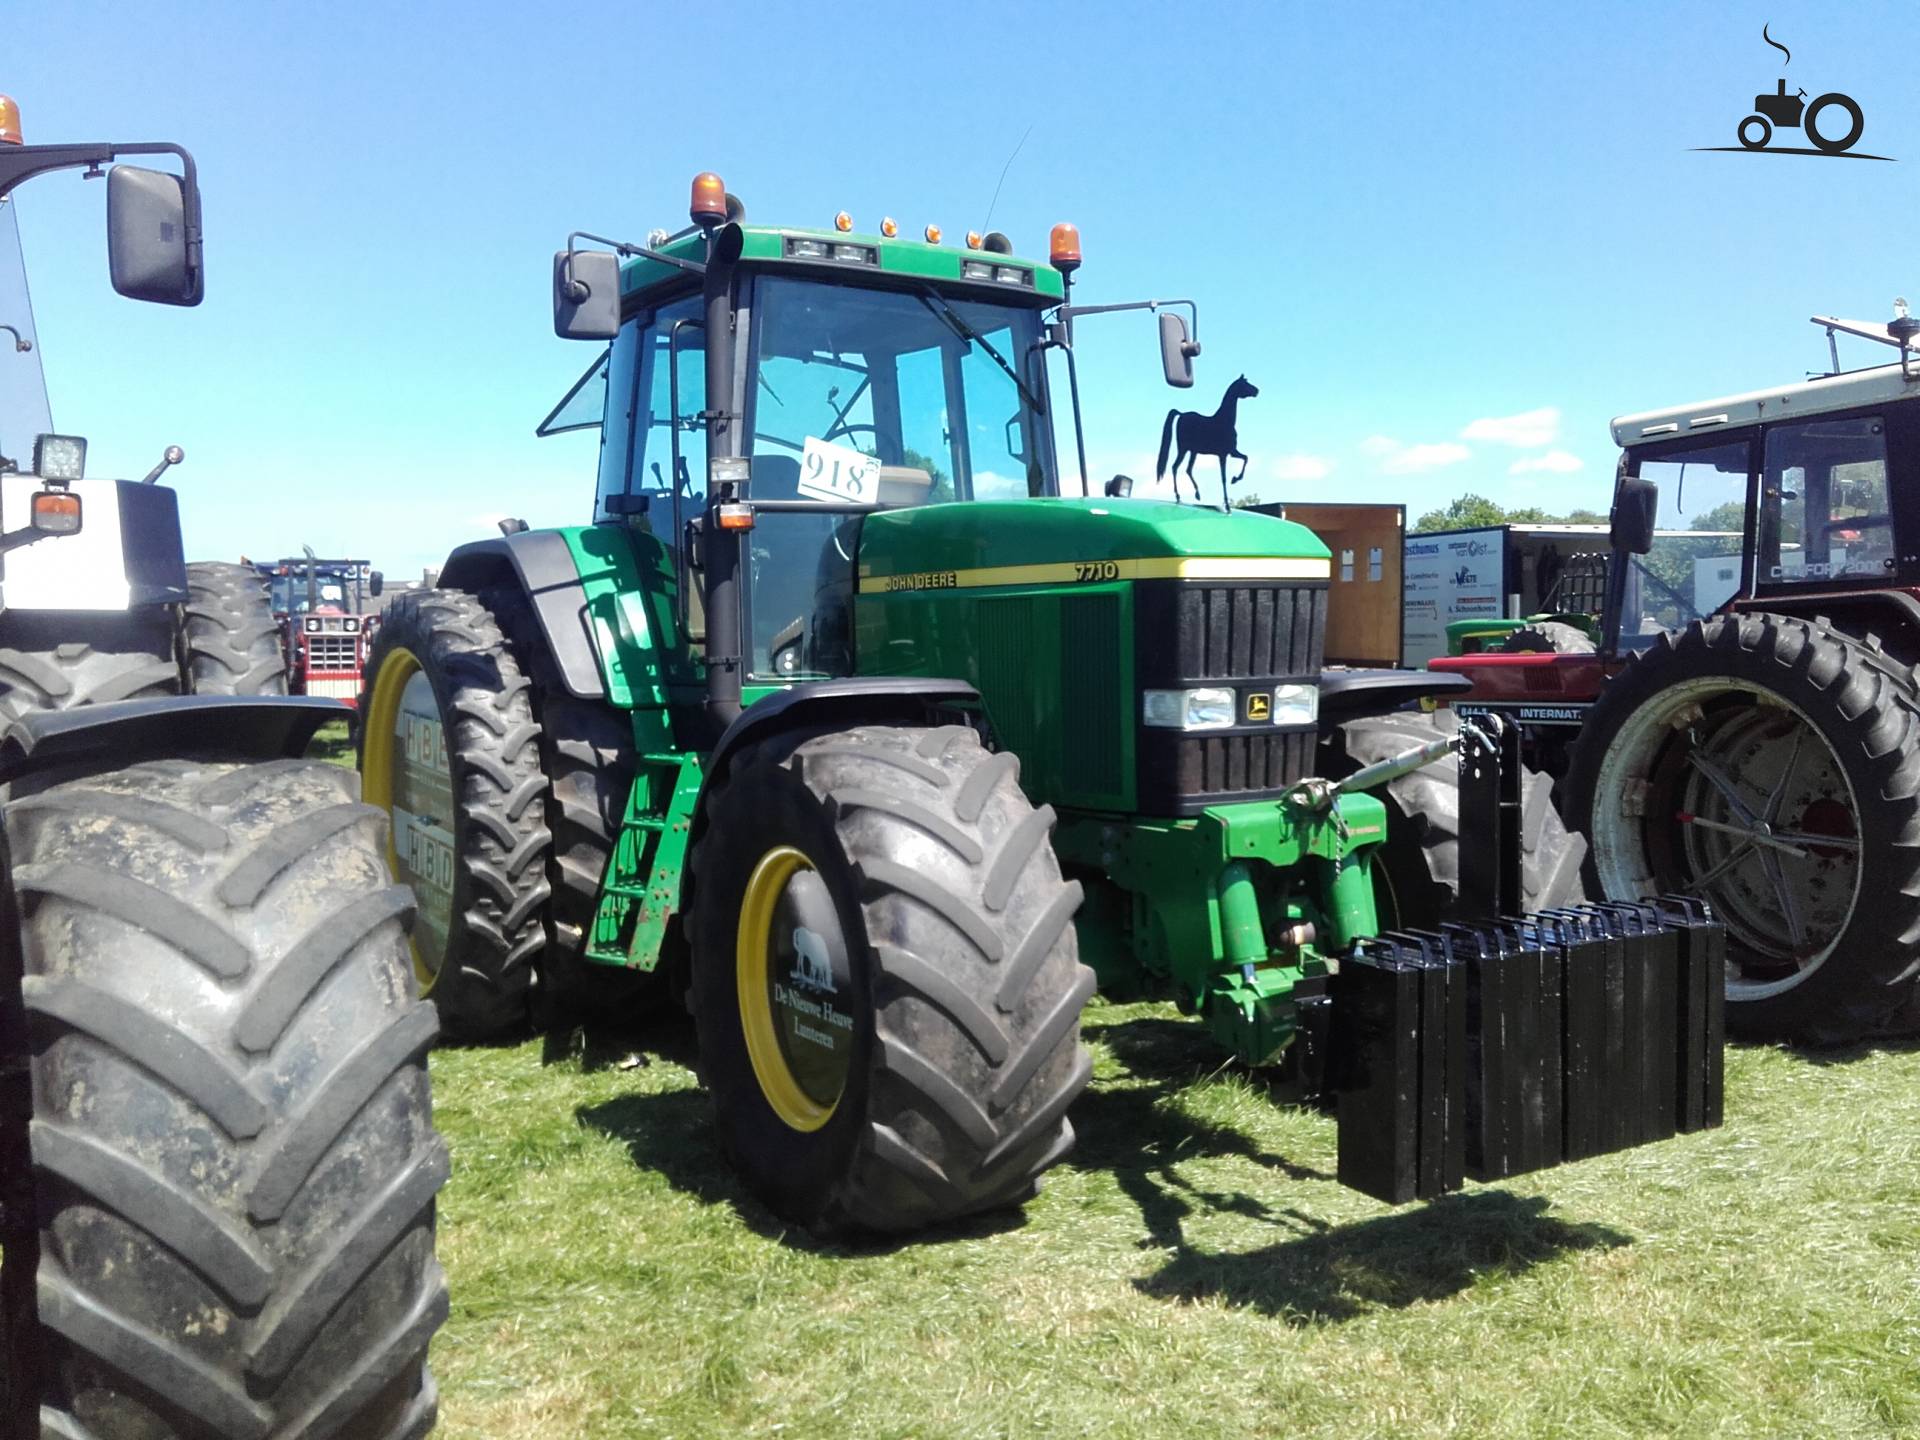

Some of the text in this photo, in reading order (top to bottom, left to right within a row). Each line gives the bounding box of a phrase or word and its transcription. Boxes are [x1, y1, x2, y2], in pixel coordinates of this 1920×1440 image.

[806, 452, 865, 496] 918
[885, 571, 957, 592] JOHN DEERE
[1075, 561, 1118, 581] 7710
[775, 983, 788, 1004] De
[788, 988, 821, 1018] Nieuwe
